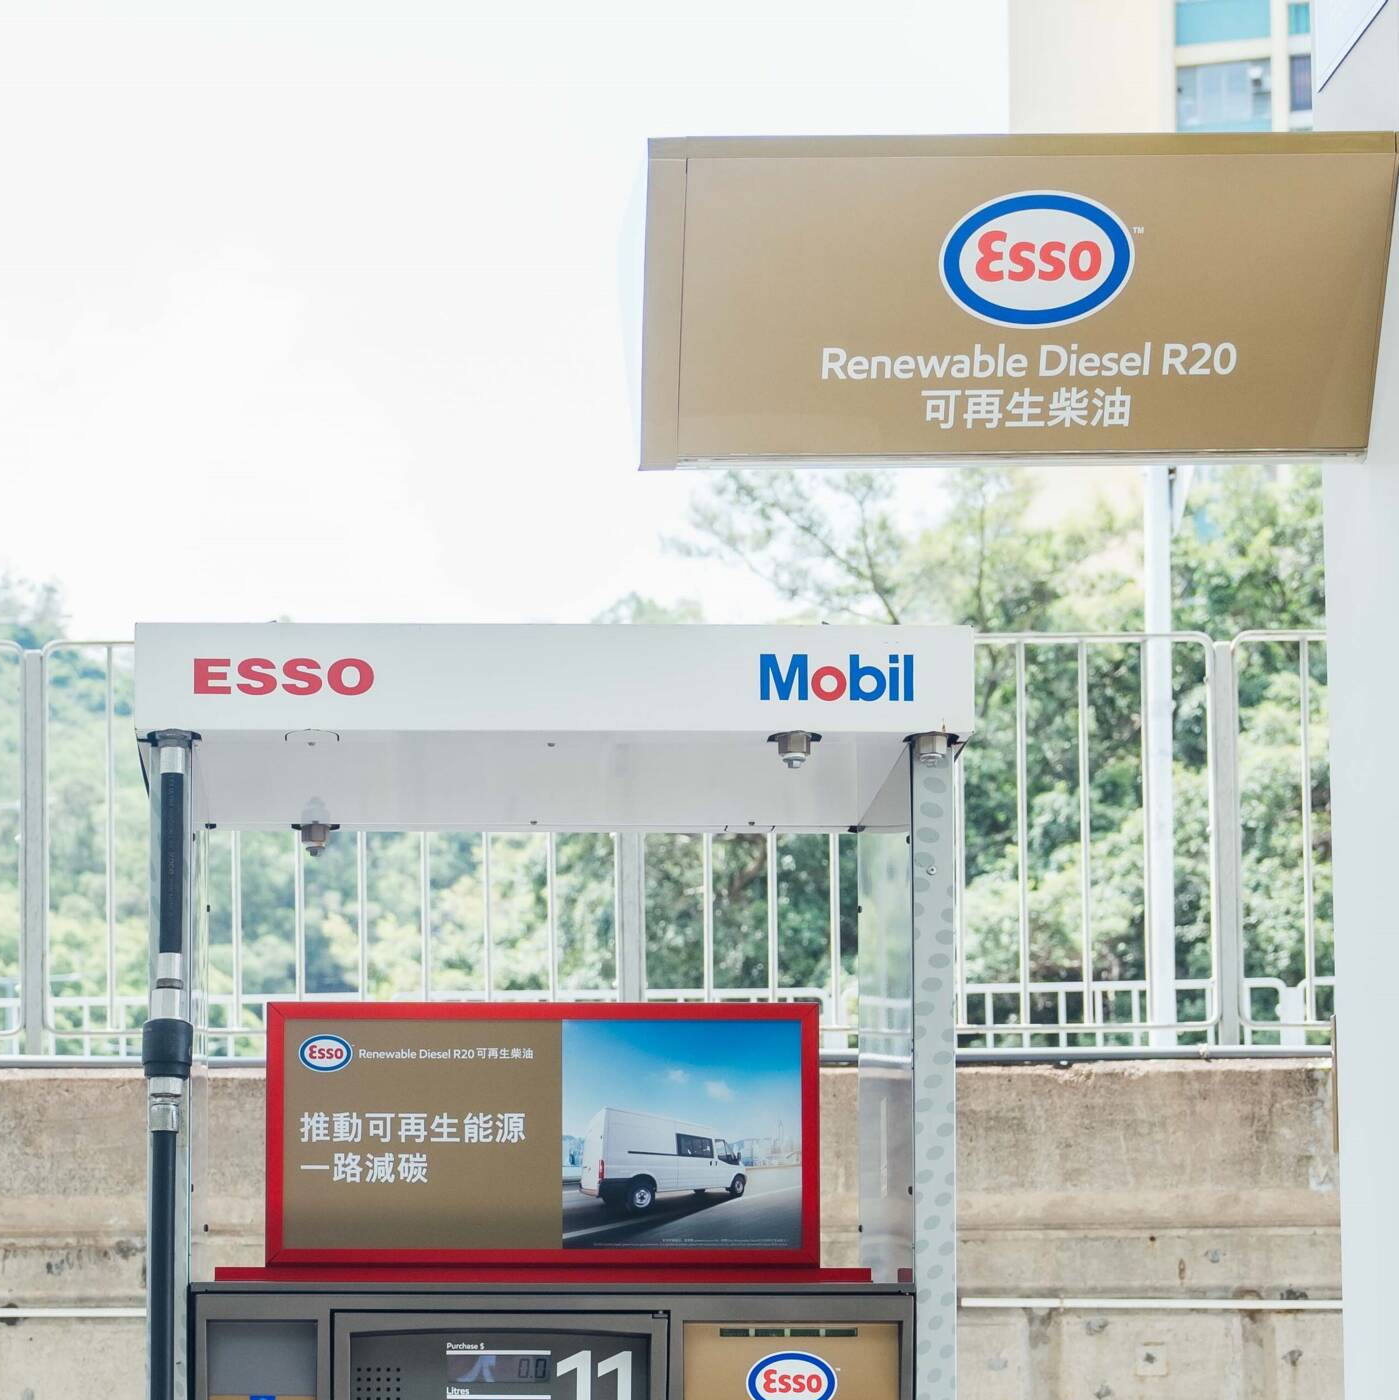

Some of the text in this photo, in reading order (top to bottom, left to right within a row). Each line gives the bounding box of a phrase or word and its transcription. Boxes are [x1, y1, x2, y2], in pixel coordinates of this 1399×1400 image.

[975, 230, 1103, 282] Esso
[821, 341, 1237, 380] Renewable Diesel R20
[920, 386, 1132, 430] 可再生柴油
[193, 657, 375, 696] ESSO
[759, 653, 915, 702] Mobil
[308, 1044, 344, 1060] Esso
[358, 1048, 417, 1060] Renewable
[419, 1048, 451, 1060] Diesel
[299, 1111, 526, 1144] 推動可再生能源
[300, 1152, 428, 1184] 一路減碳
[446, 1342, 485, 1350] Purchase $
[446, 1386, 470, 1395] Litres
[762, 1368, 823, 1394] Esso
